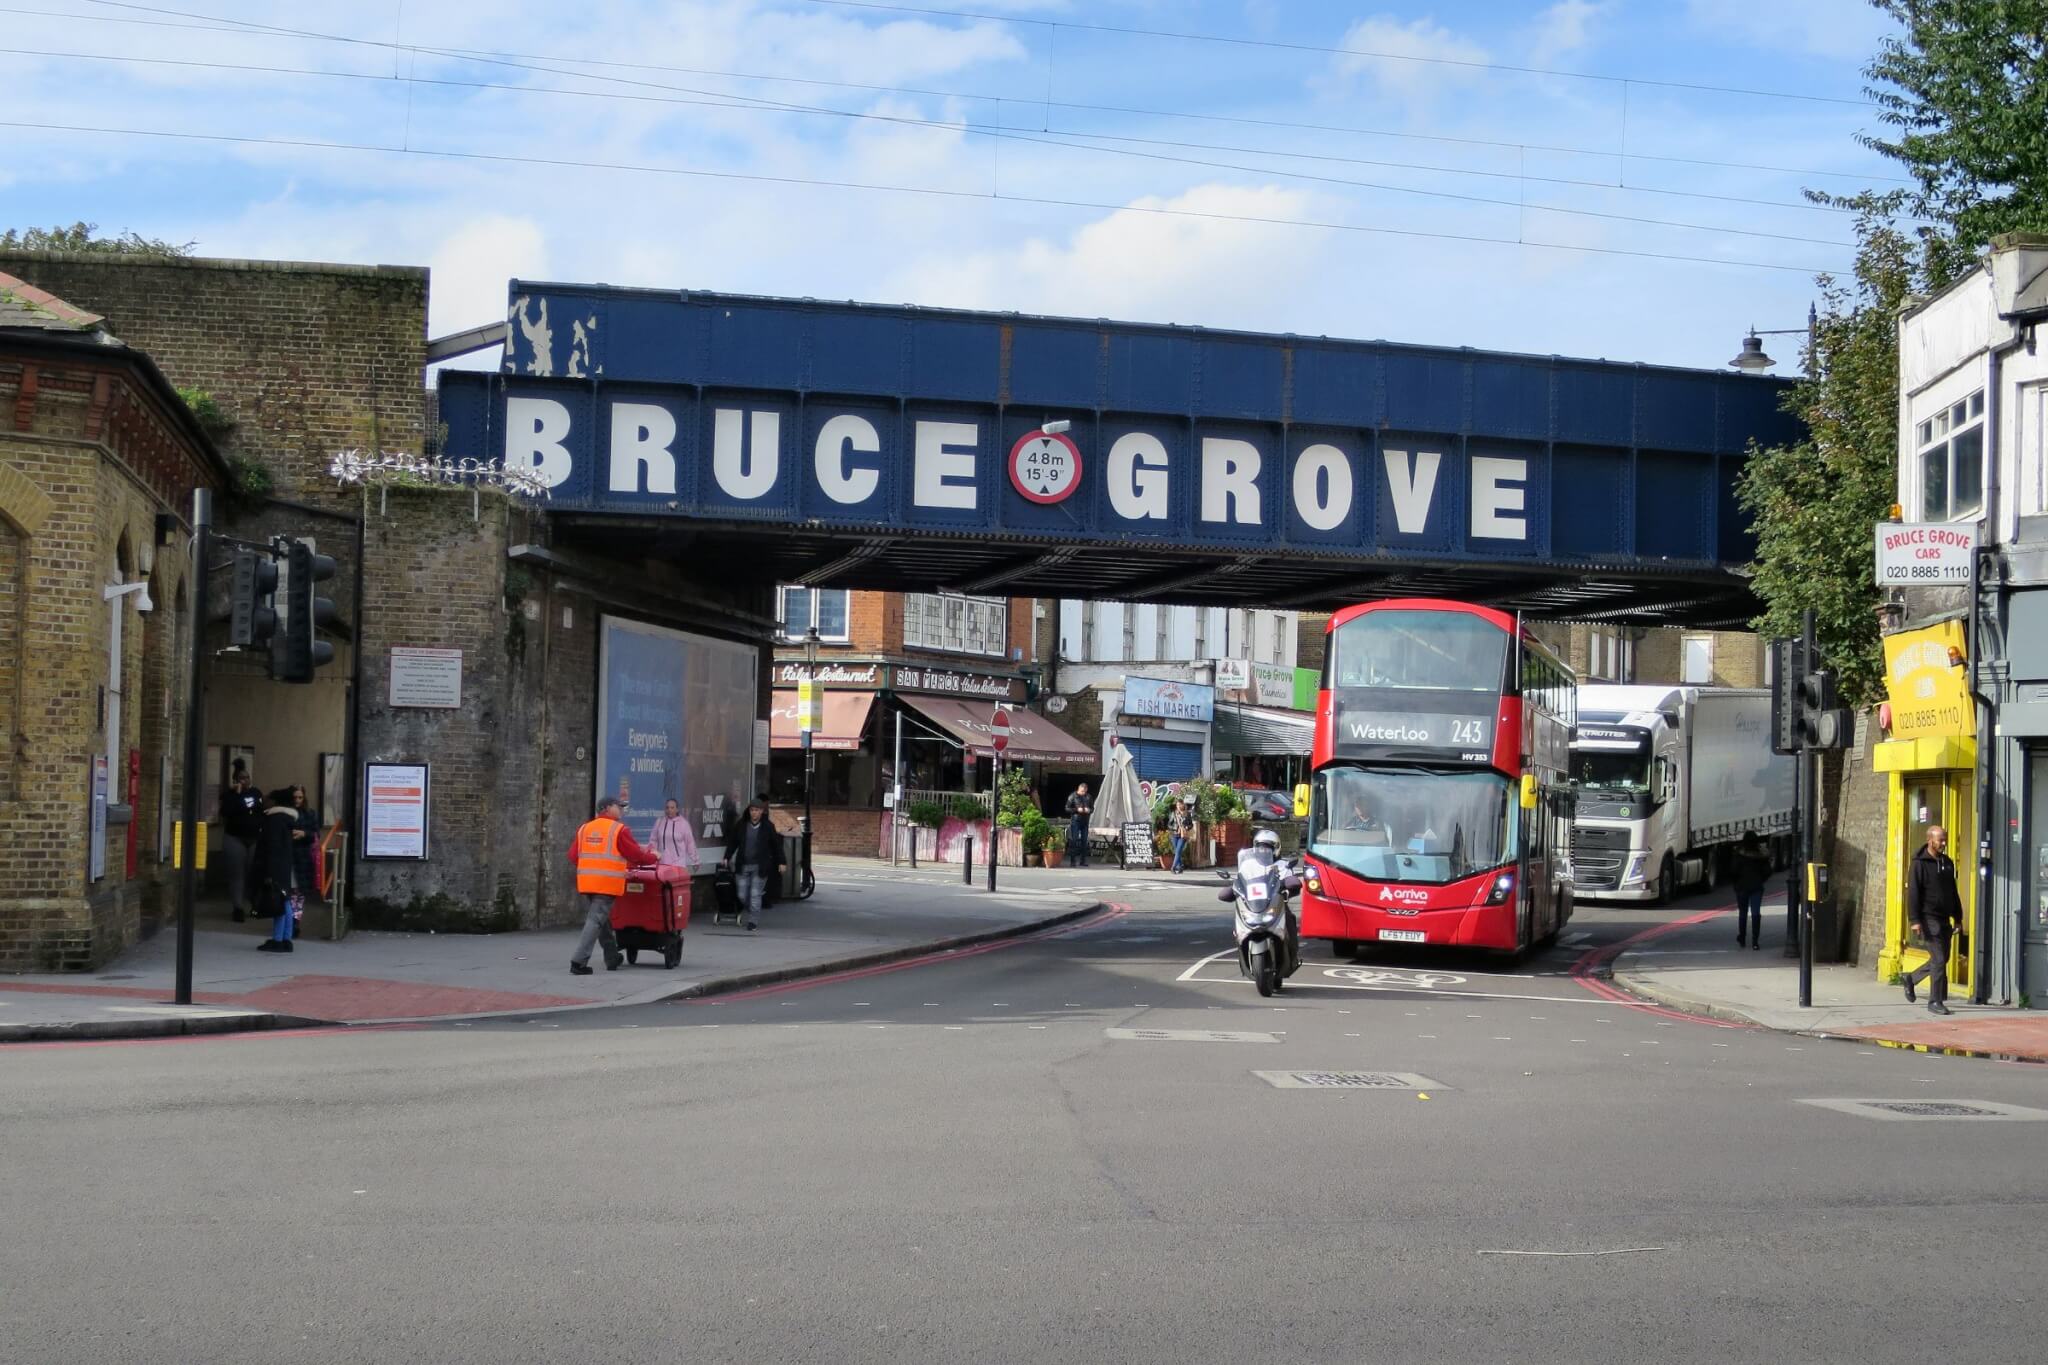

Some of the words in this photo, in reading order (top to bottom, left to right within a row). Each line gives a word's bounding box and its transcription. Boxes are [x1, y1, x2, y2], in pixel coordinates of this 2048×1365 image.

[505, 397, 978, 510] BRUCE
[1107, 432, 1527, 540] GROVE
[1885, 529, 1925, 550] BRUCE
[1929, 529, 1971, 550] GROVE
[1915, 548, 1942, 559] CARS
[1887, 566, 1908, 578] 020
[1911, 566, 1940, 578] 8885
[1943, 566, 1969, 578] 1110
[897, 670, 919, 687] SAN
[923, 672, 960, 691] MARCO
[1273, 669, 1293, 683] Grove
[1137, 698, 1160, 714] FISH
[1164, 701, 1201, 720] MARKET
[1899, 712, 1914, 729] 020
[1915, 709, 1937, 728] 8885
[1939, 706, 1959, 725] 1110
[628, 728, 669, 752] Everyone's
[1350, 723, 1429, 741] Waterloo
[1452, 719, 1483, 744] 243
[630, 758, 637, 773] a
[702, 809, 724, 824] HALIFAX
[1252, 885, 1262, 896] L
[1394, 888, 1428, 900] arriva
